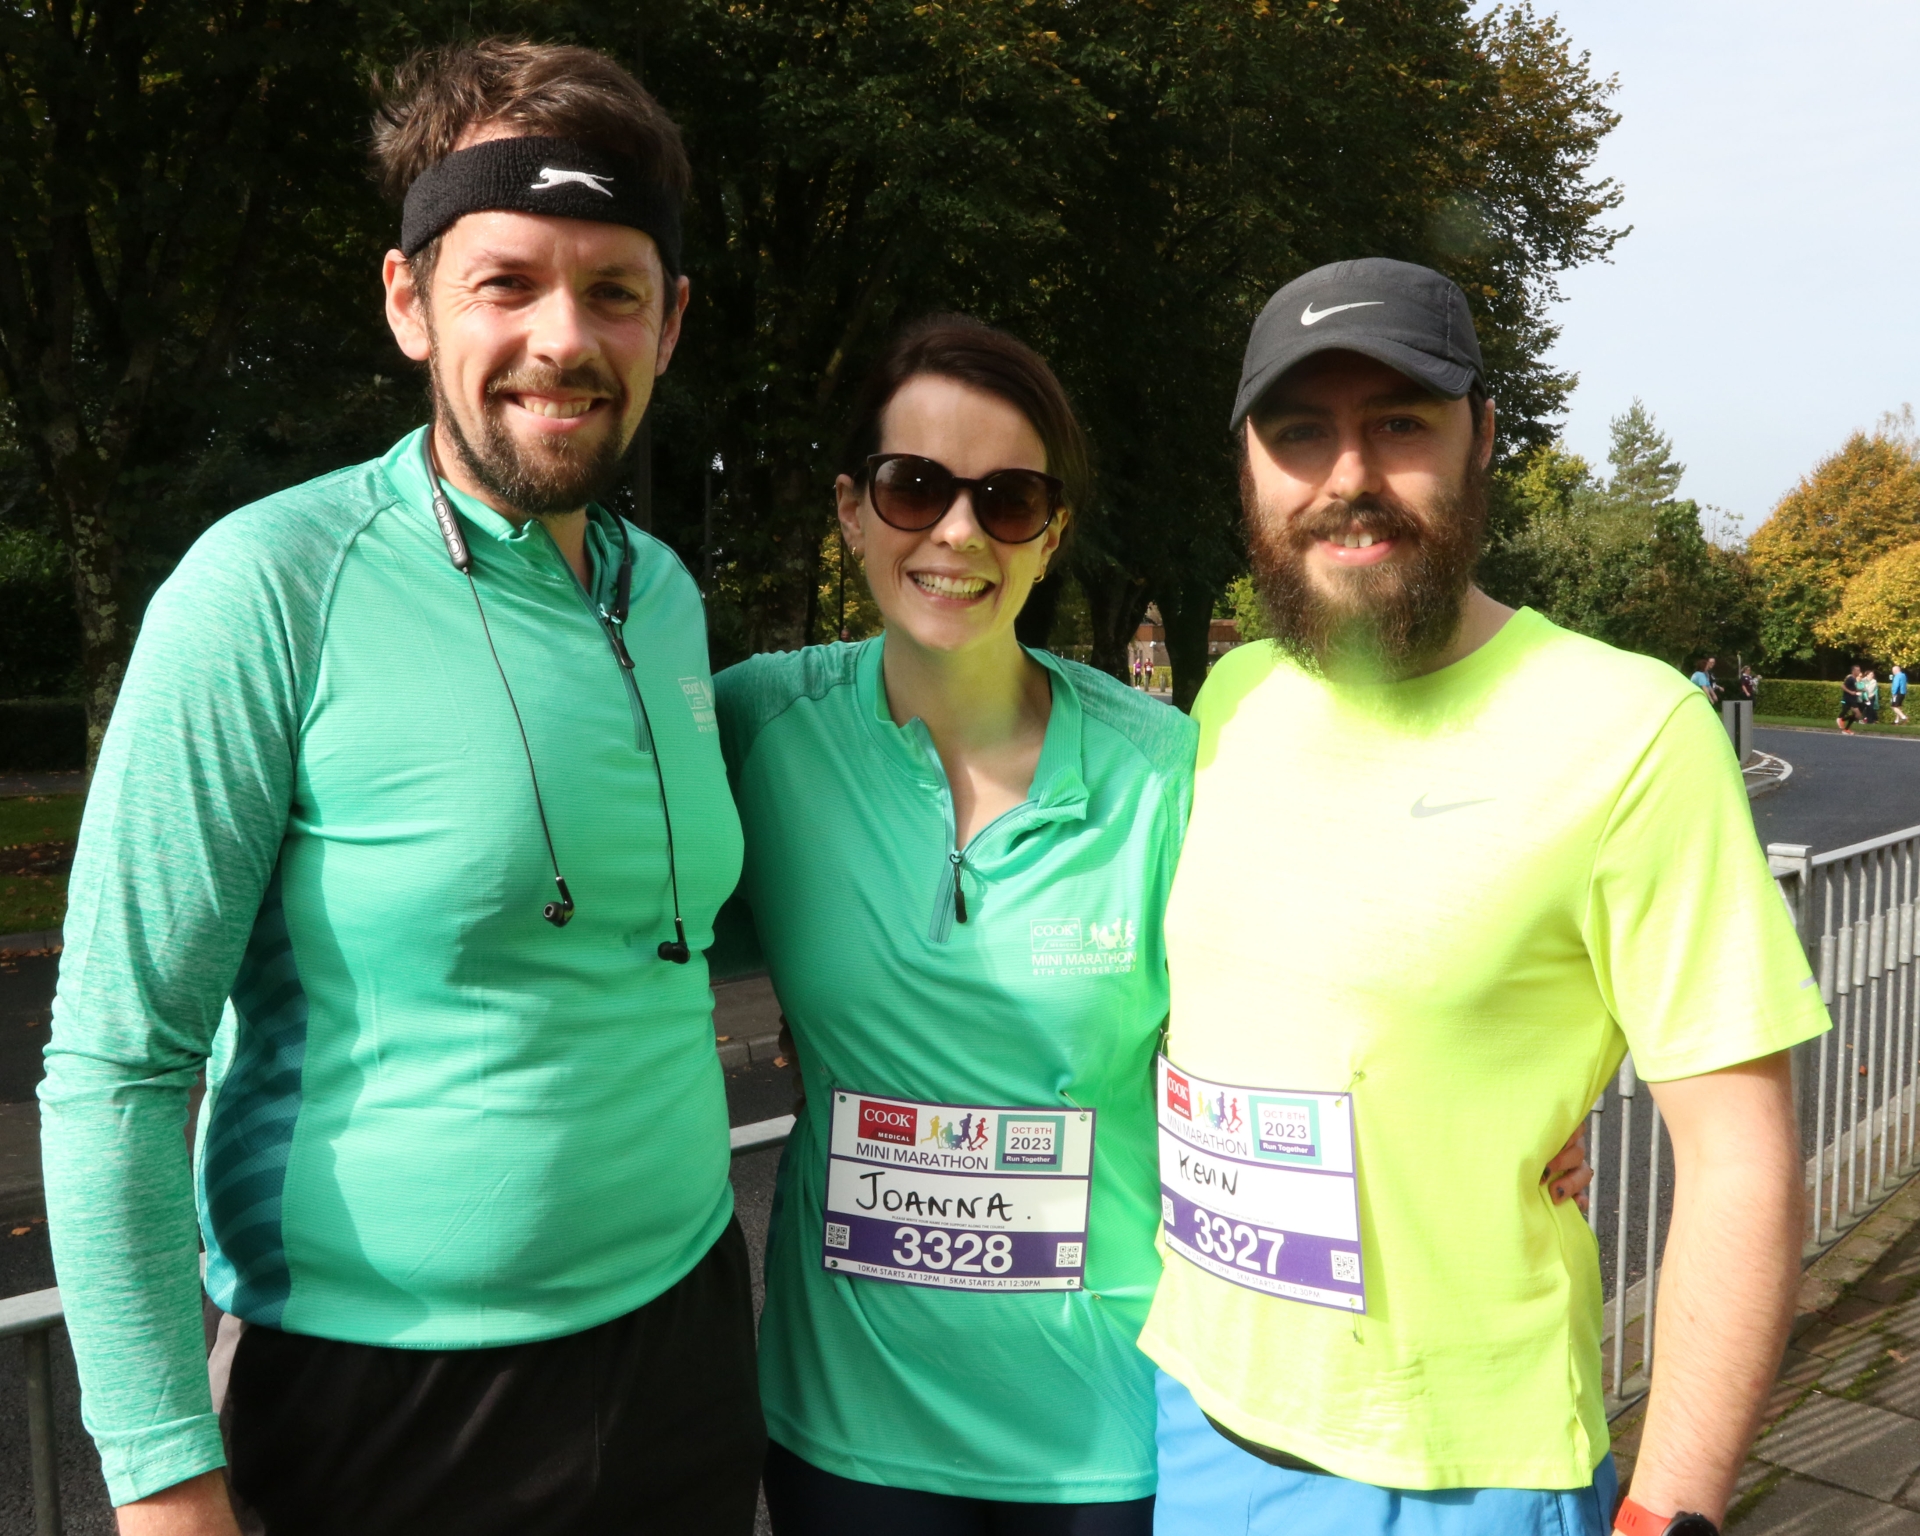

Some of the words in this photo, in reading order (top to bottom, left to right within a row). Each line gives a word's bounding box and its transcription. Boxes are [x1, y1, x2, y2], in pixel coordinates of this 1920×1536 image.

[1033, 924, 1074, 936] COOK
[1032, 954, 1062, 966] MINI
[1066, 952, 1137, 965] MARATHON
[1033, 968, 1055, 976] 8TH
[1061, 966, 1110, 976] OCTOBER
[1167, 1076, 1188, 1101] COOK
[1264, 1110, 1284, 1119] OCT
[1287, 1112, 1306, 1120] 8TH
[877, 1131, 910, 1142] MEDICAL
[1011, 1126, 1032, 1134] OCT
[1033, 1127, 1052, 1135] 8TH
[1264, 1121, 1307, 1139] 2023
[1010, 1137, 1051, 1151] 2023
[1183, 1122, 1248, 1156] MARATHON
[1262, 1142, 1276, 1151] Run
[1278, 1144, 1308, 1154] Together
[856, 1142, 890, 1161] MINI
[893, 1147, 988, 1170] MARATHON
[1021, 1156, 1051, 1164] Together
[1194, 1208, 1285, 1275] 3327
[892, 1227, 1013, 1274] 3328
[858, 1264, 878, 1274] 10KM
[880, 1267, 906, 1279] STARTS
[907, 1271, 918, 1280] AT
[920, 1273, 940, 1283] 12PM
[950, 1278, 967, 1286] 5KM
[969, 1279, 996, 1287] STARTS
[998, 1279, 1008, 1287] AT
[1009, 1279, 1041, 1287] 12:30PM
[1236, 1272, 1250, 1283] 5KM
[1252, 1277, 1276, 1289] STARTS
